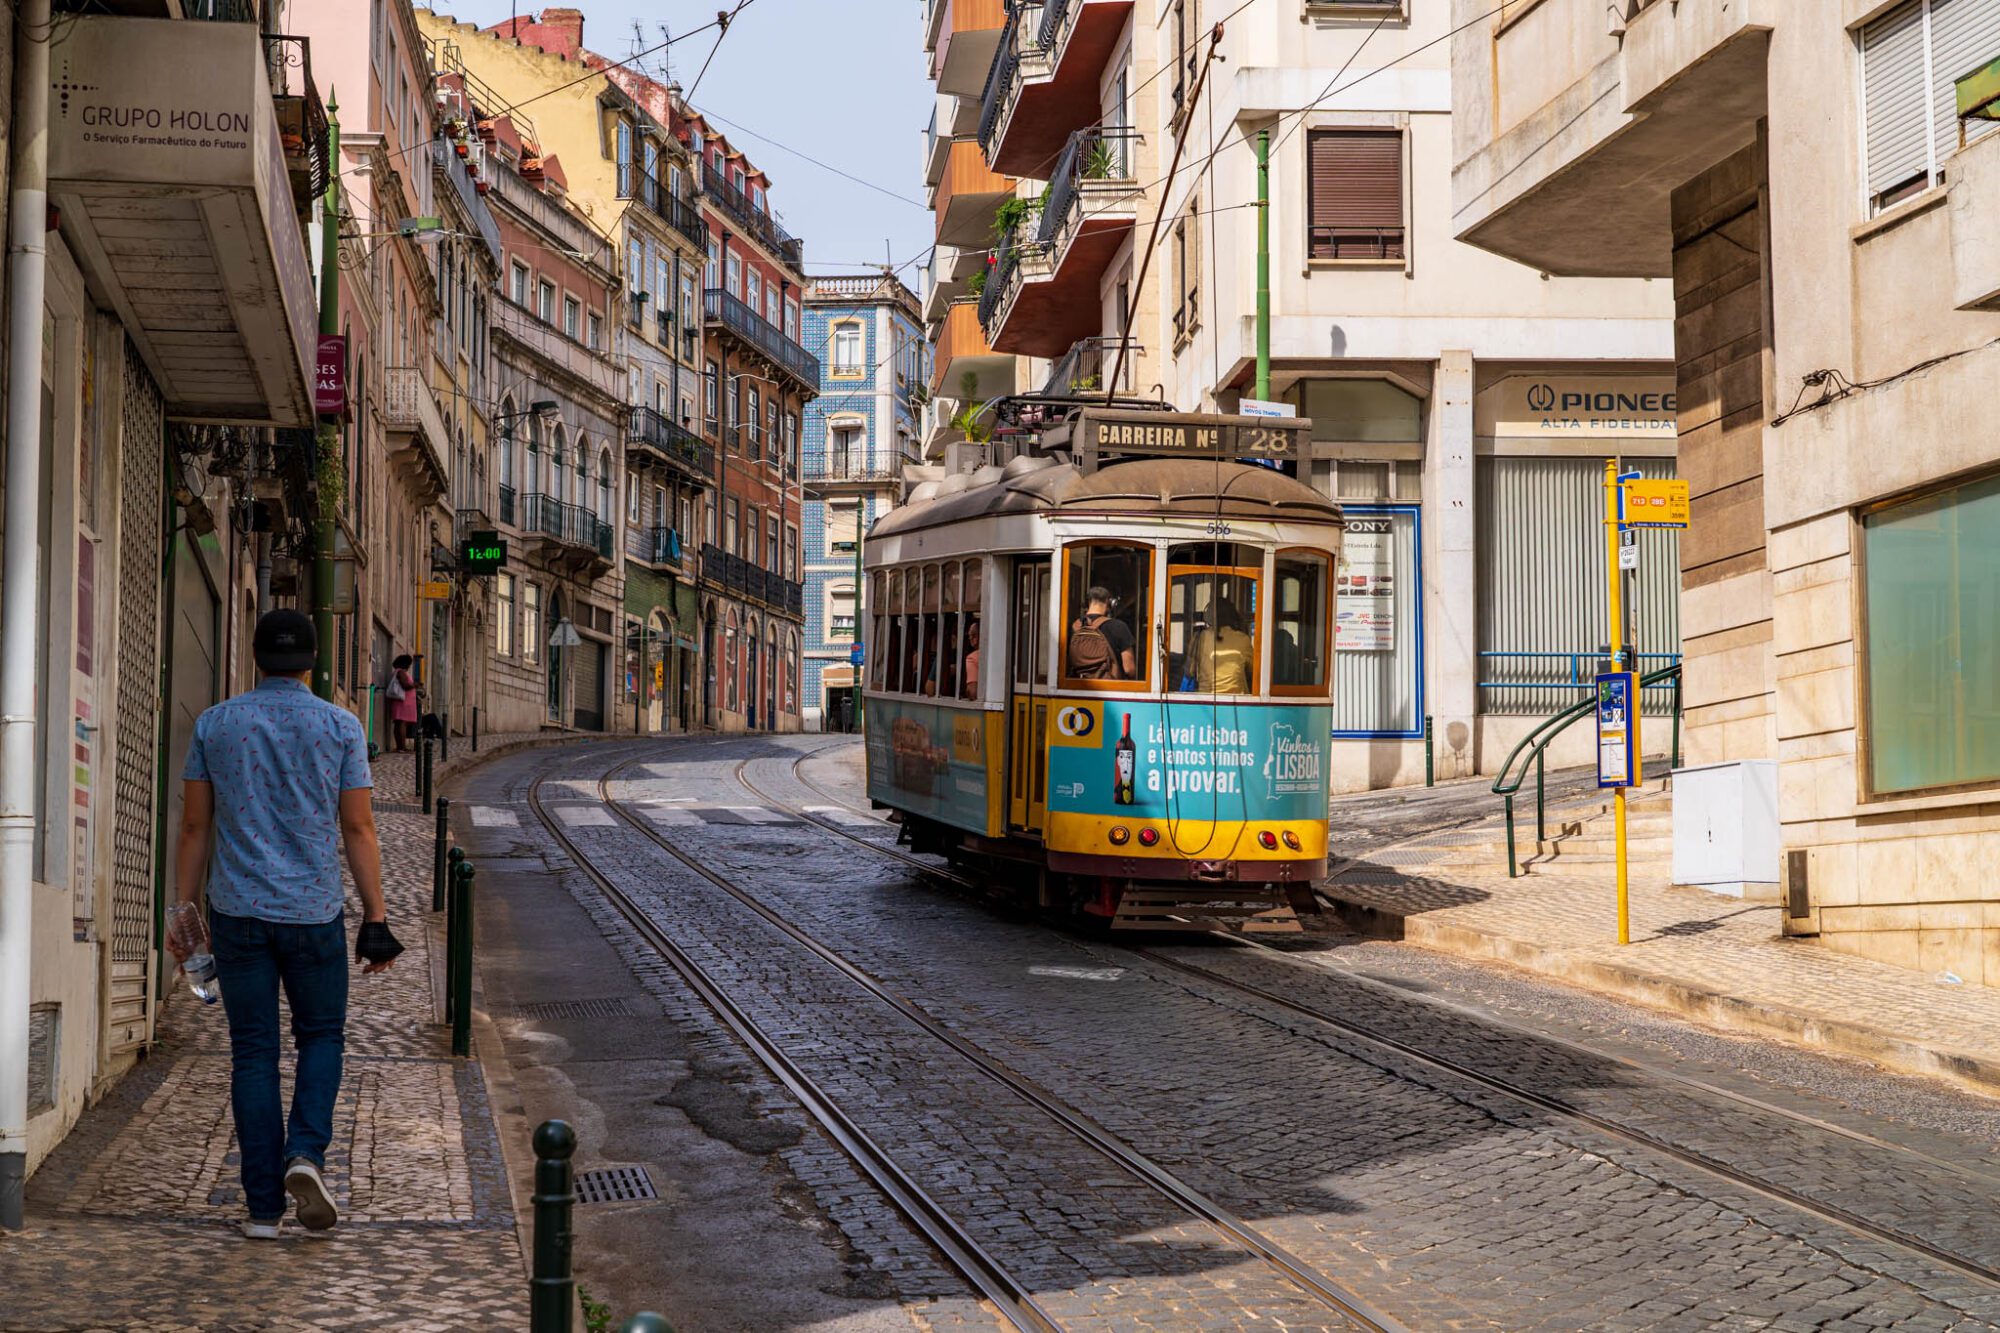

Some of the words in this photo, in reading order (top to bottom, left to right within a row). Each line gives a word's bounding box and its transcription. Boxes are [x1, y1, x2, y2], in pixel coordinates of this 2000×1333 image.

[82, 106, 161, 129] GRUPO
[170, 110, 249, 133] HOLON
[83, 132, 91, 142] O
[94, 133, 129, 145] Serviço
[132, 134, 197, 147] Farmacêutico
[199, 137, 212, 148] do
[214, 138, 247, 149] Futuro
[1540, 418, 1581, 429] ALTA
[1590, 418, 1677, 429] FIDELIDA
[1098, 424, 1186, 447] CARREIRA
[1196, 429, 1218, 448] Nº
[1250, 428, 1288, 452] 28
[1170, 724, 1195, 745] vai
[1199, 724, 1248, 746] Lisboa
[1277, 734, 1312, 753] Vinhos
[1147, 749, 1157, 764] e
[1161, 747, 1207, 765] tantos
[1210, 748, 1255, 767] vinhos
[1275, 754, 1320, 780] LISBOA
[1147, 768, 1160, 791] a
[1167, 769, 1241, 799] provar.
